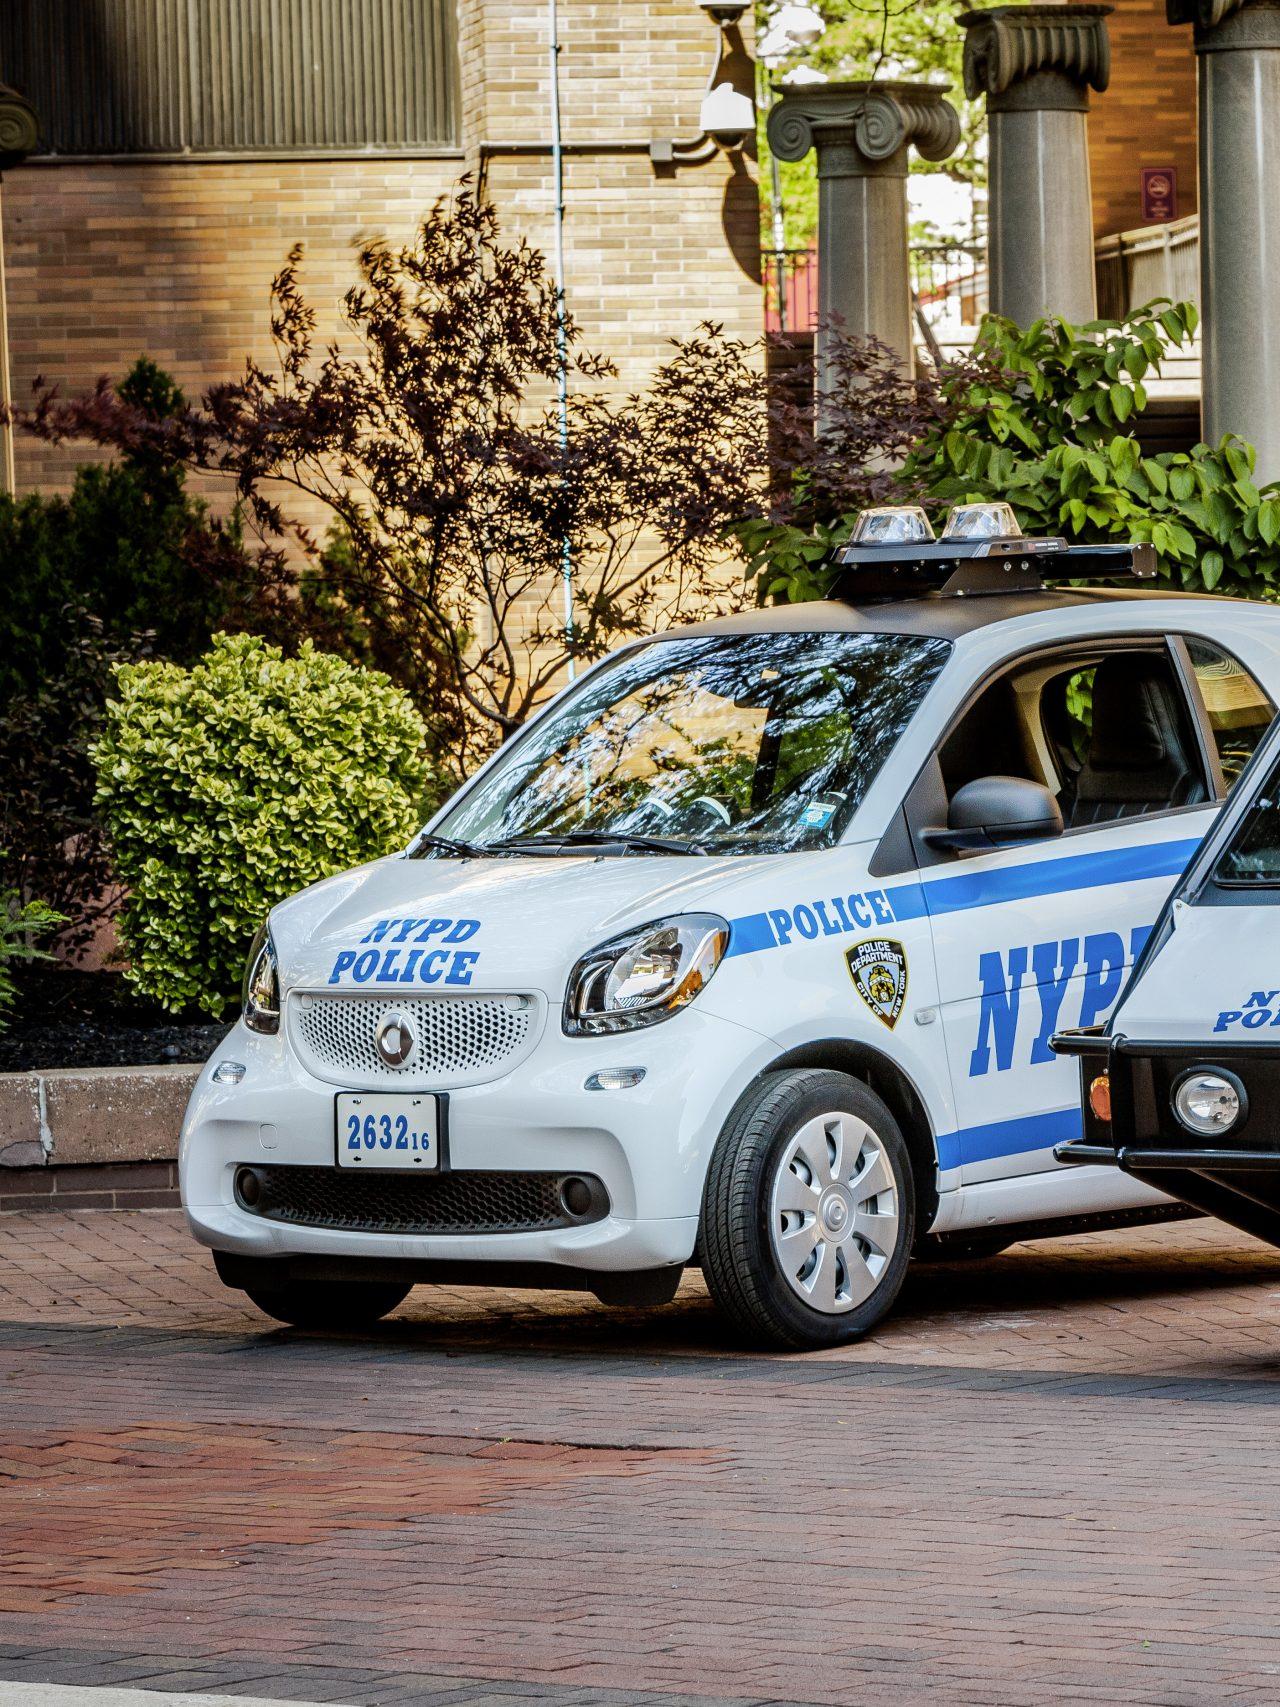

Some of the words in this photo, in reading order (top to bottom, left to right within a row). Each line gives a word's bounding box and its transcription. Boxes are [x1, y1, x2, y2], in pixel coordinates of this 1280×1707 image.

[360, 918, 482, 944] NYPD
[766, 889, 895, 946] POLICE
[850, 951, 904, 974] DEPARTMENT
[857, 941, 891, 957] POLICE
[328, 949, 481, 986] POLICE
[856, 981, 873, 1004] CITY
[872, 1004, 884, 1017] OF
[891, 996, 903, 1018] NEW
[898, 970, 906, 995] YORK
